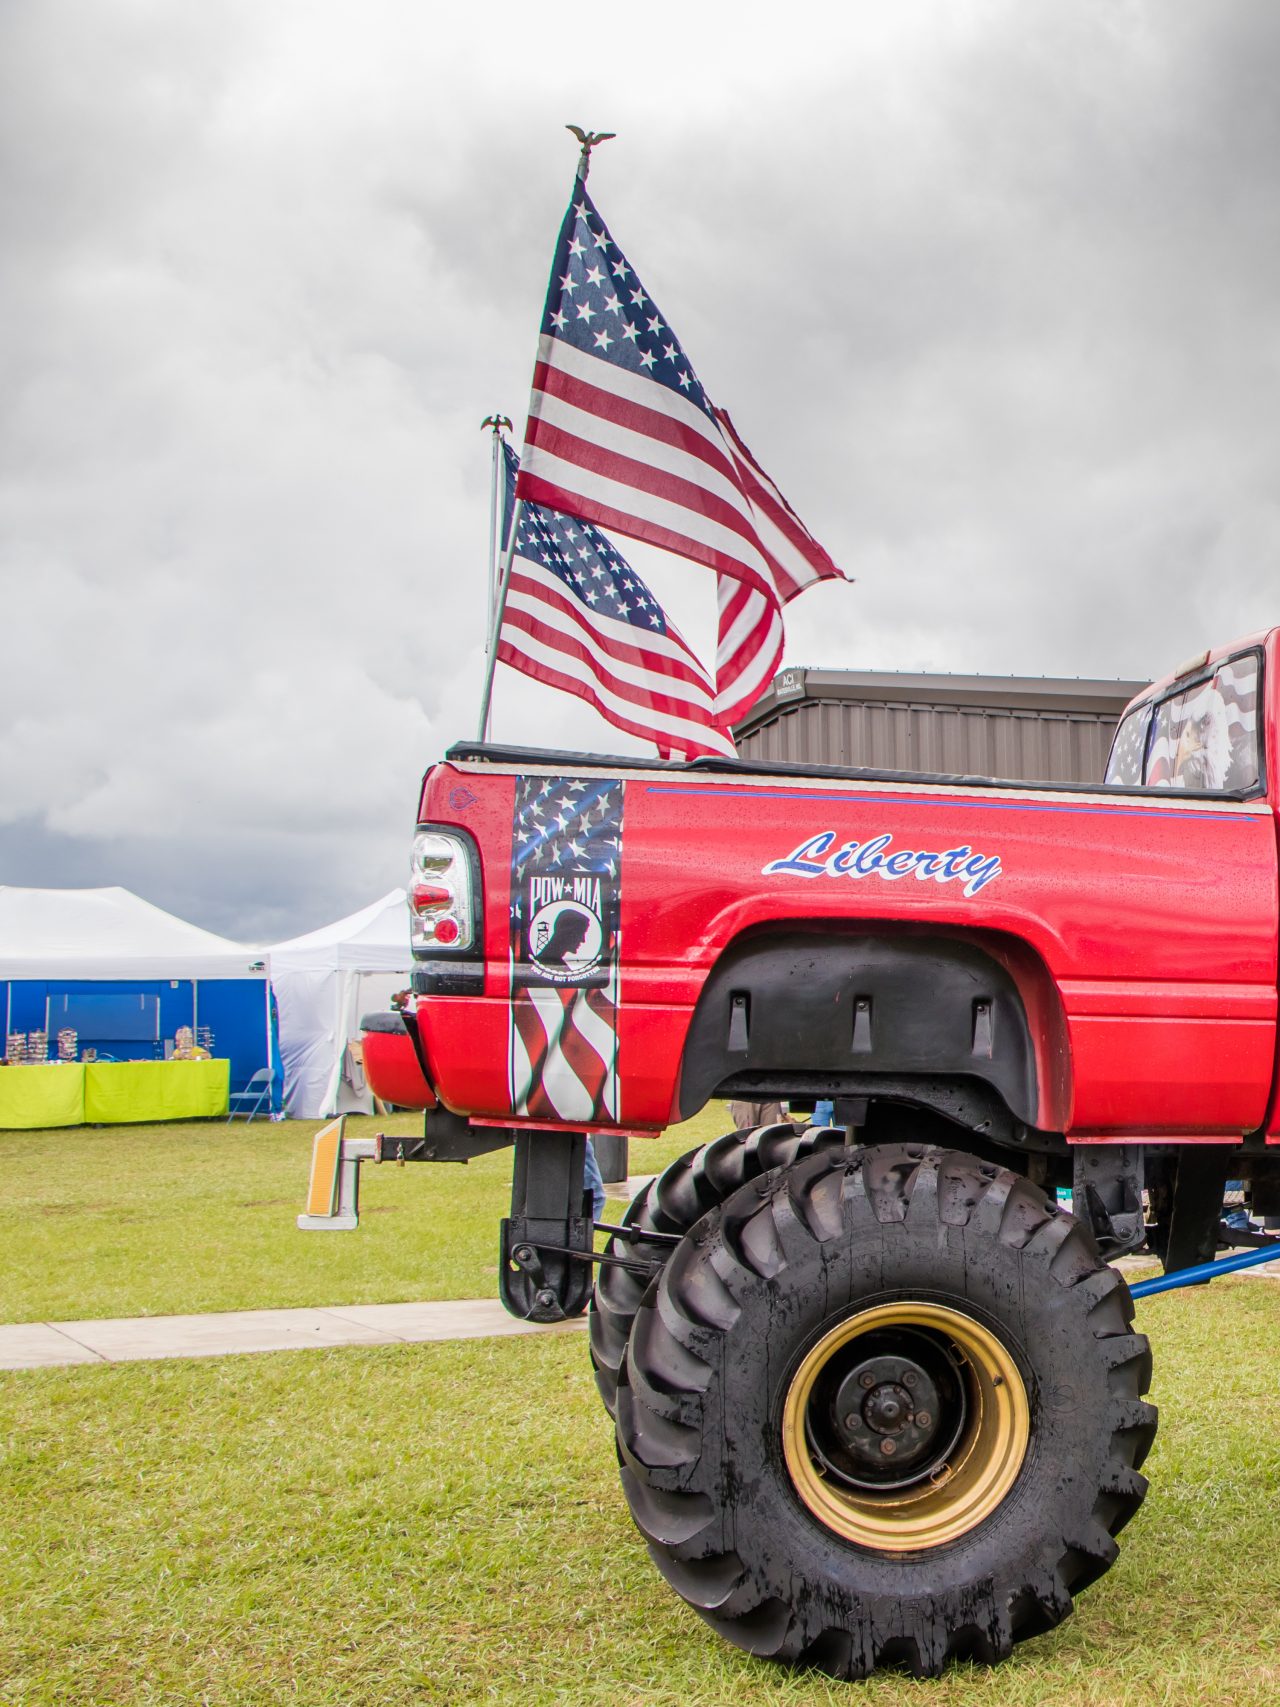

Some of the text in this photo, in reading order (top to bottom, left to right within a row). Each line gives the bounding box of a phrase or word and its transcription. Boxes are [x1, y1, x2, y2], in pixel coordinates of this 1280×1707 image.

[761, 831, 1002, 897] Liberty
[529, 876, 603, 922] POW MIA
